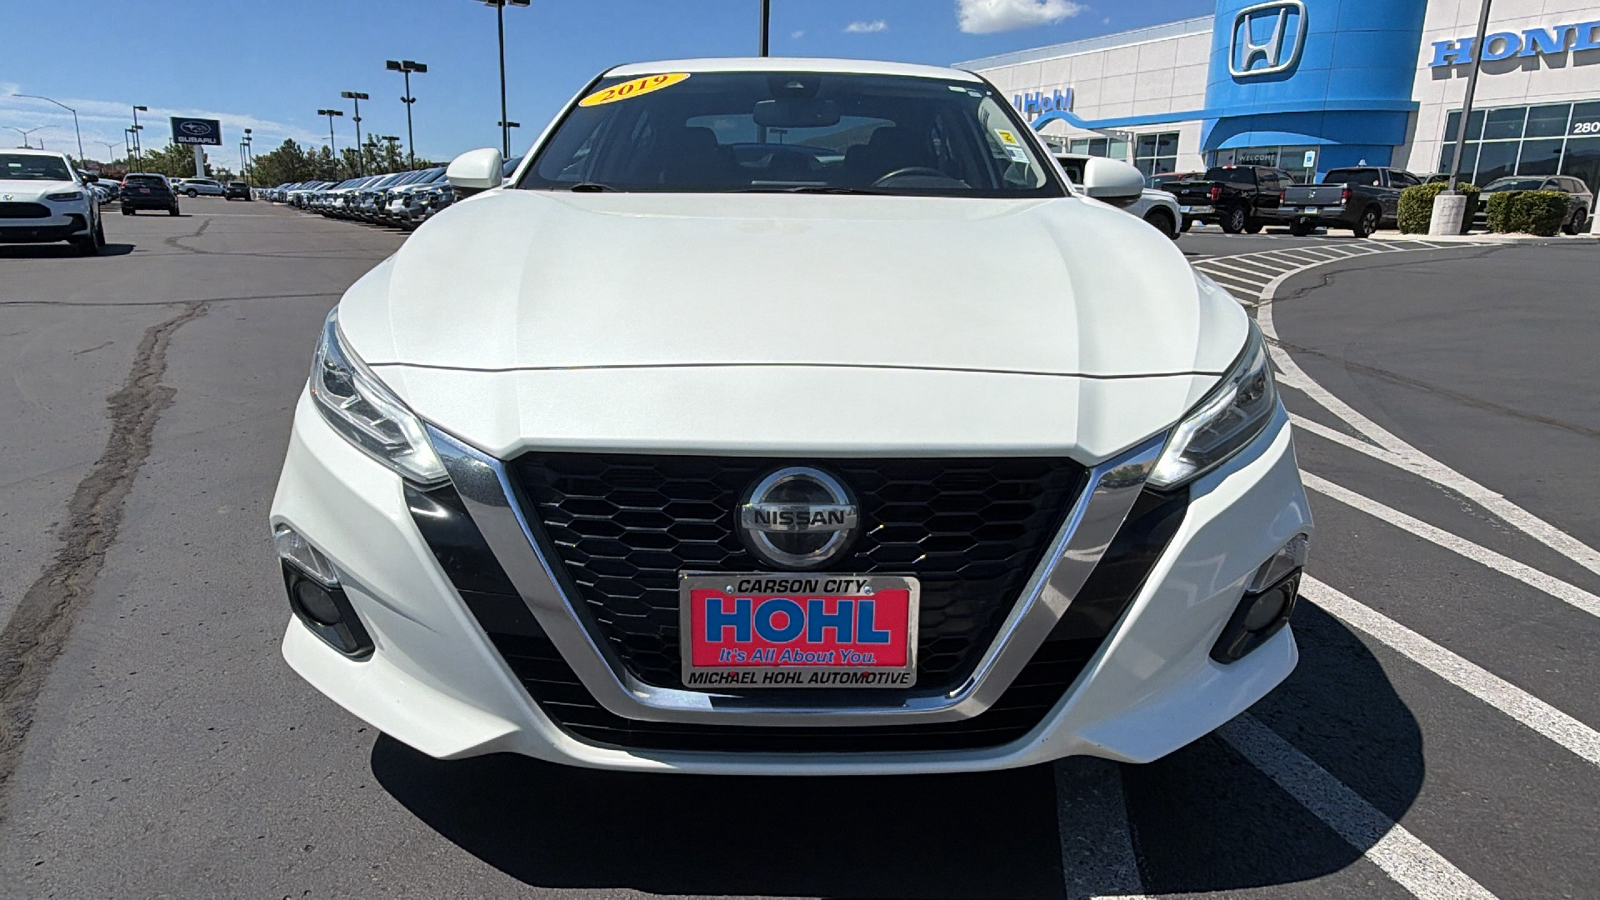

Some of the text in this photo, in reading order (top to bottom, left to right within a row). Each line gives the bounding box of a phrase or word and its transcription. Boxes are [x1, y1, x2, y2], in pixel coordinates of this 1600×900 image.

[600, 75, 668, 102] 2019
[1024, 88, 1072, 112] Hohl
[754, 511, 844, 526] NISSAN
[737, 580, 868, 594] CARSON CITY
[705, 598, 890, 644] HOHL
[719, 648, 876, 663] It's All About You.
[688, 671, 910, 685] MICHAEL HOHL AUTOMOTIVE
